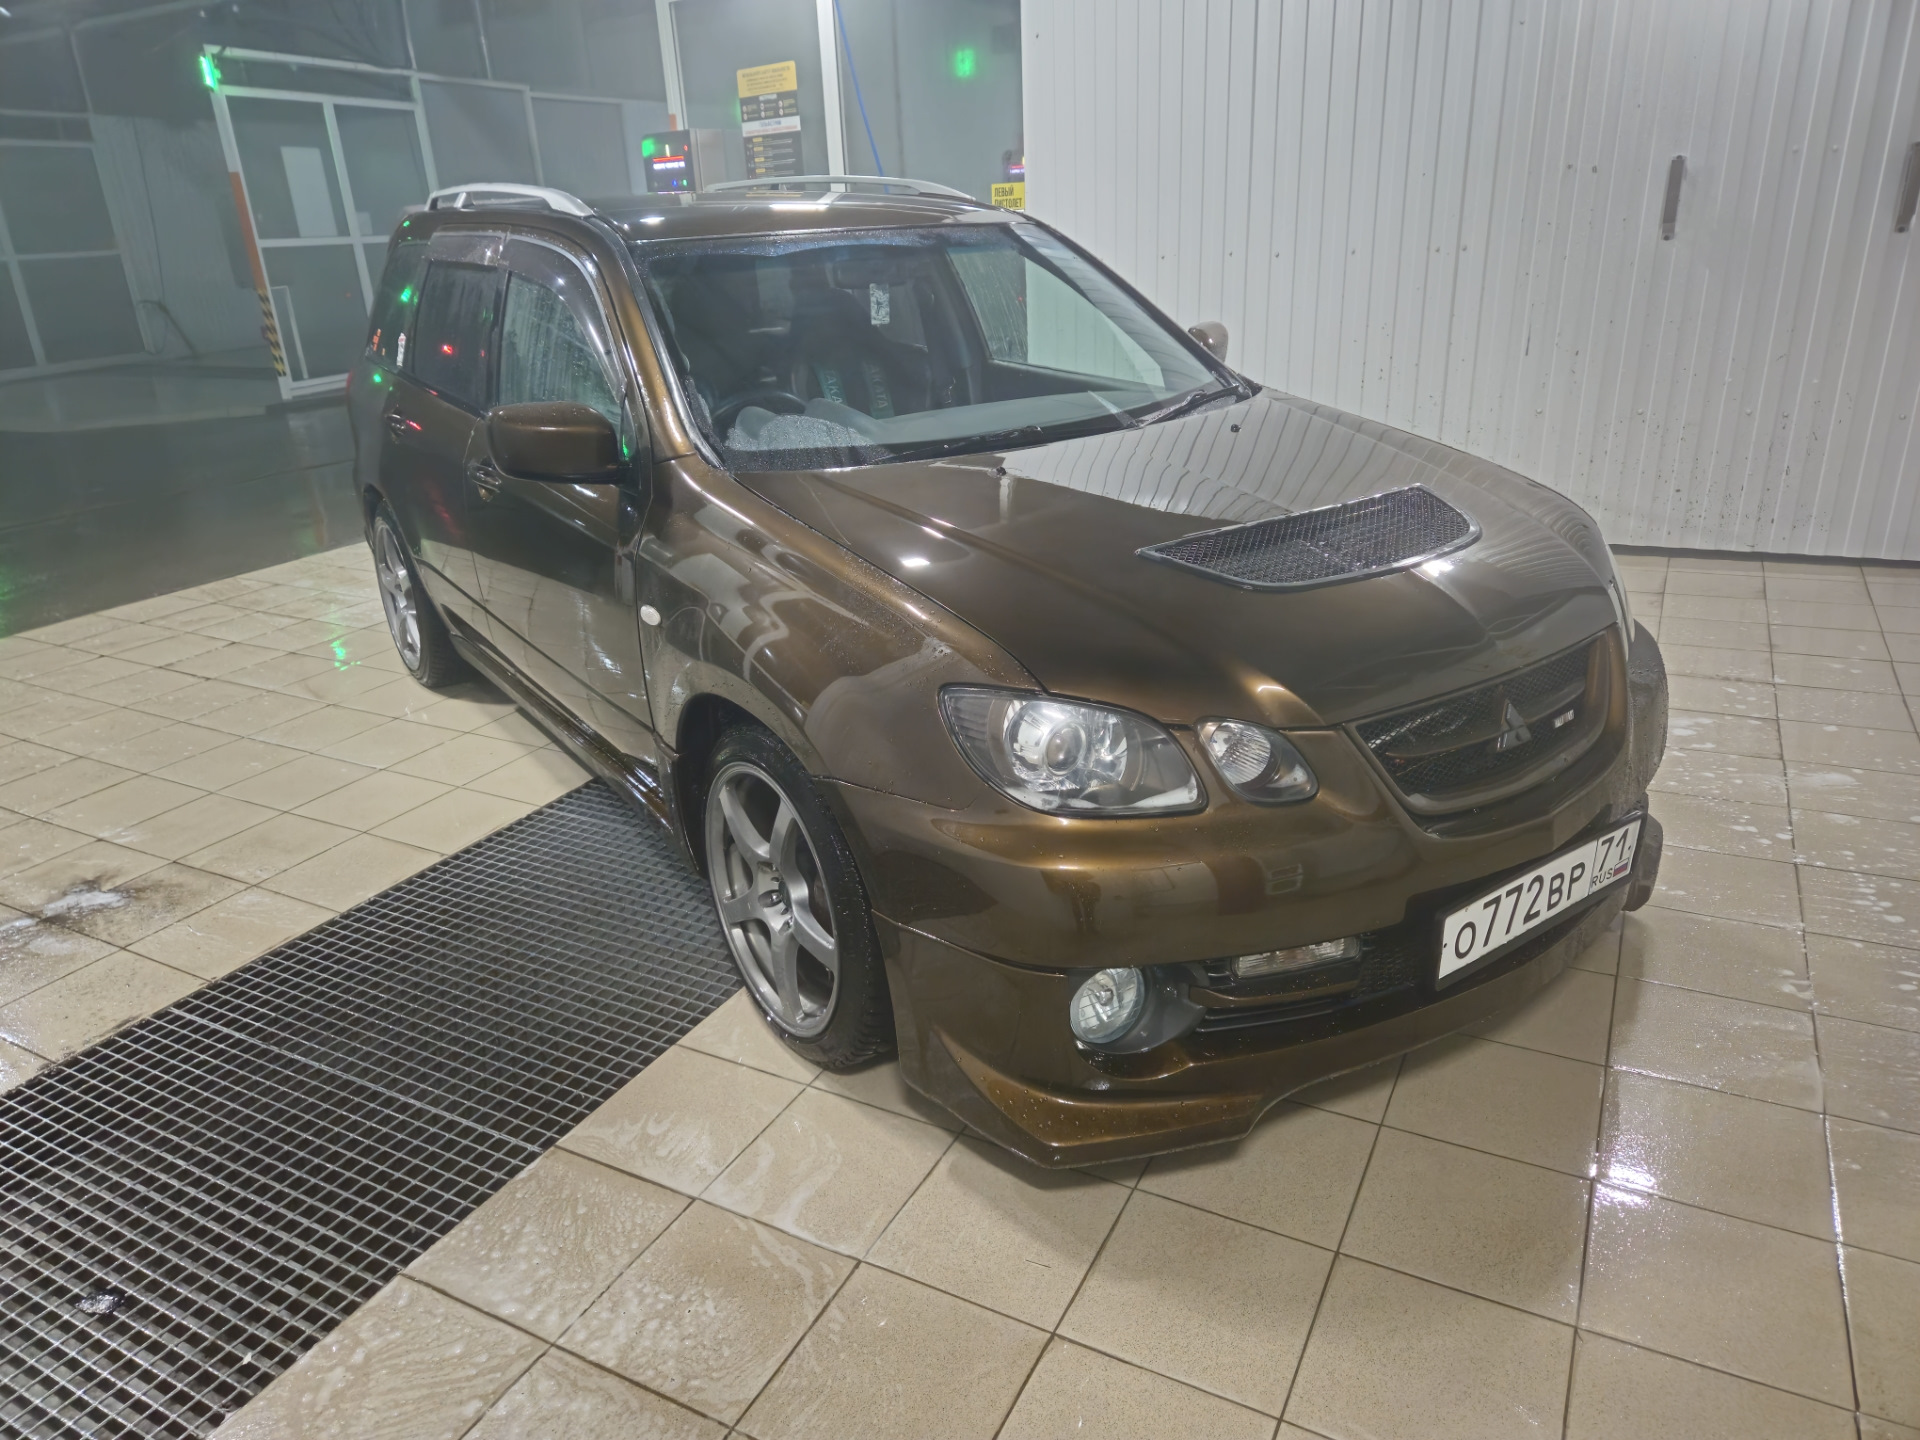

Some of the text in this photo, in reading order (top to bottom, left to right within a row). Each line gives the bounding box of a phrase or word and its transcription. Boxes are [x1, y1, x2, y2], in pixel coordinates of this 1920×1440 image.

[994, 185, 1014, 198] ЛЕВЫЙ
[1598, 827, 1630, 873] 71
[1592, 867, 1614, 888] RUS
